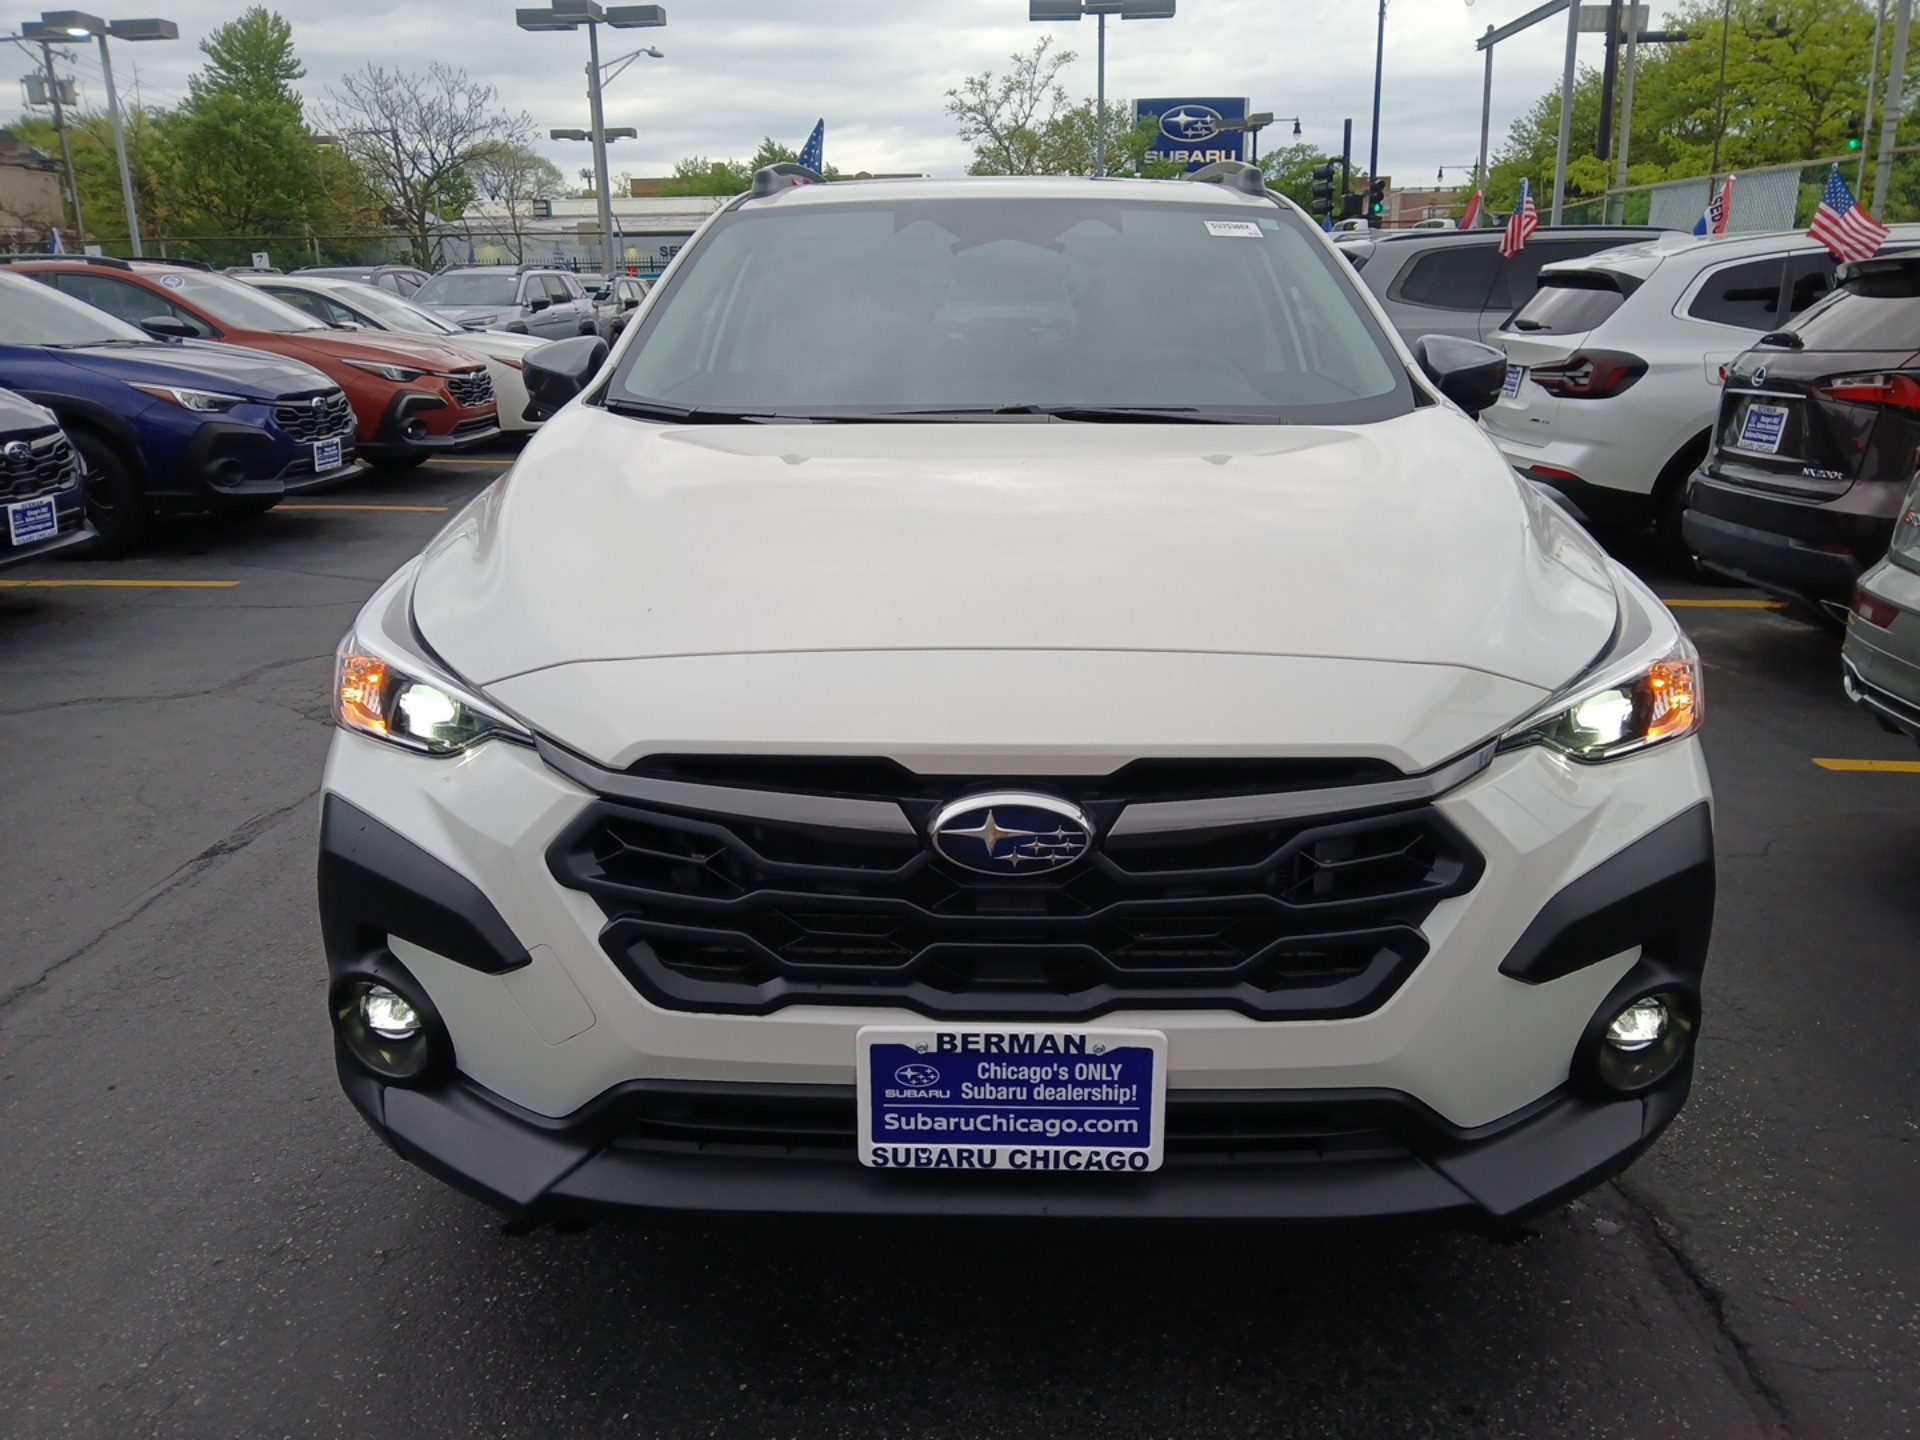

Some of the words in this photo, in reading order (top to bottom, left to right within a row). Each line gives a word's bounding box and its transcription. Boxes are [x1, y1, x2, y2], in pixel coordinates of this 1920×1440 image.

[1143, 149, 1236, 164] SUBARU
[1709, 191, 1724, 223] SED
[936, 1032, 1087, 1055] BERMAN
[977, 1062, 1069, 1083] Chicago's
[1074, 1063, 1123, 1081] ONLY
[885, 1089, 950, 1098] SUBARU
[961, 1082, 1027, 1100] Subaru
[1033, 1083, 1137, 1104] dealership!
[883, 1113, 1138, 1137] SubaruChicago.com
[871, 1146, 997, 1169] SUBARU
[1008, 1148, 1150, 1171] CHICAGO
